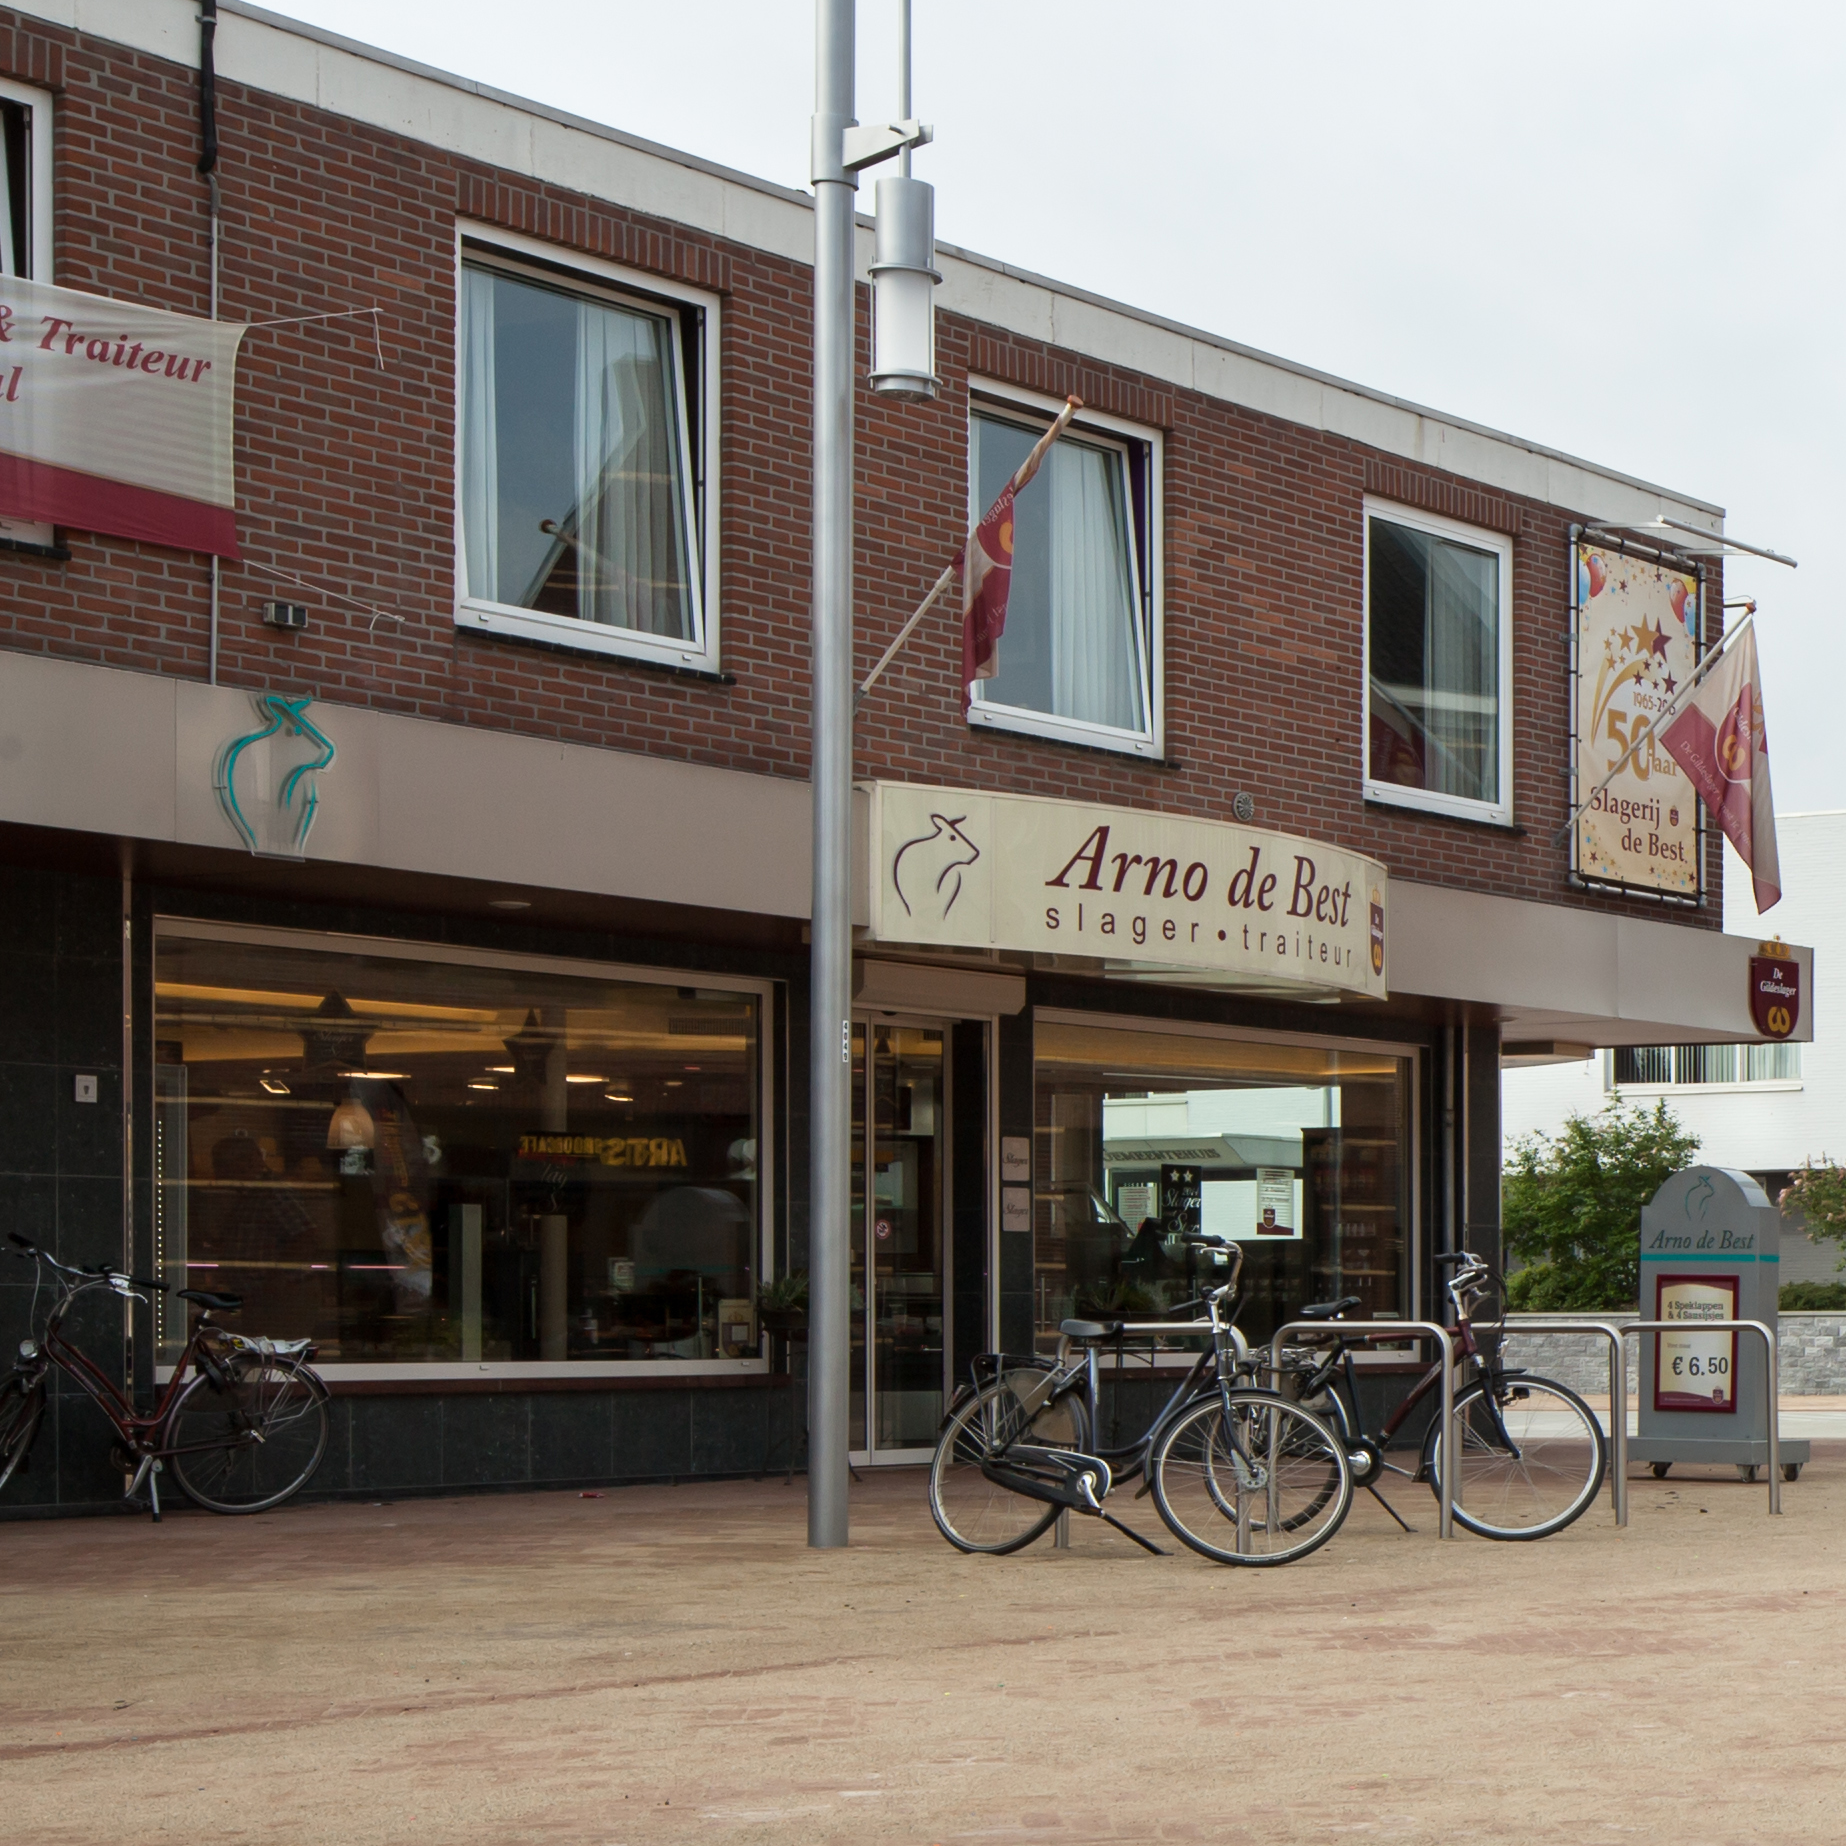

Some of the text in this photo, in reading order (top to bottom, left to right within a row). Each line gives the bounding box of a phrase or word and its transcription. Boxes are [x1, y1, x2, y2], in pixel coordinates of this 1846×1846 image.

[36, 315, 212, 383] Traiteur
[1590, 786, 1660, 830] Slagerij
[1621, 827, 1643, 854] de
[1044, 825, 1352, 928] Arno de Best
[1045, 903, 1200, 945] slager
[1242, 923, 1352, 968] traiteur
[1649, 1229, 1754, 1249] Arno de Best
[1671, 1356, 1729, 1377] € 6.50
